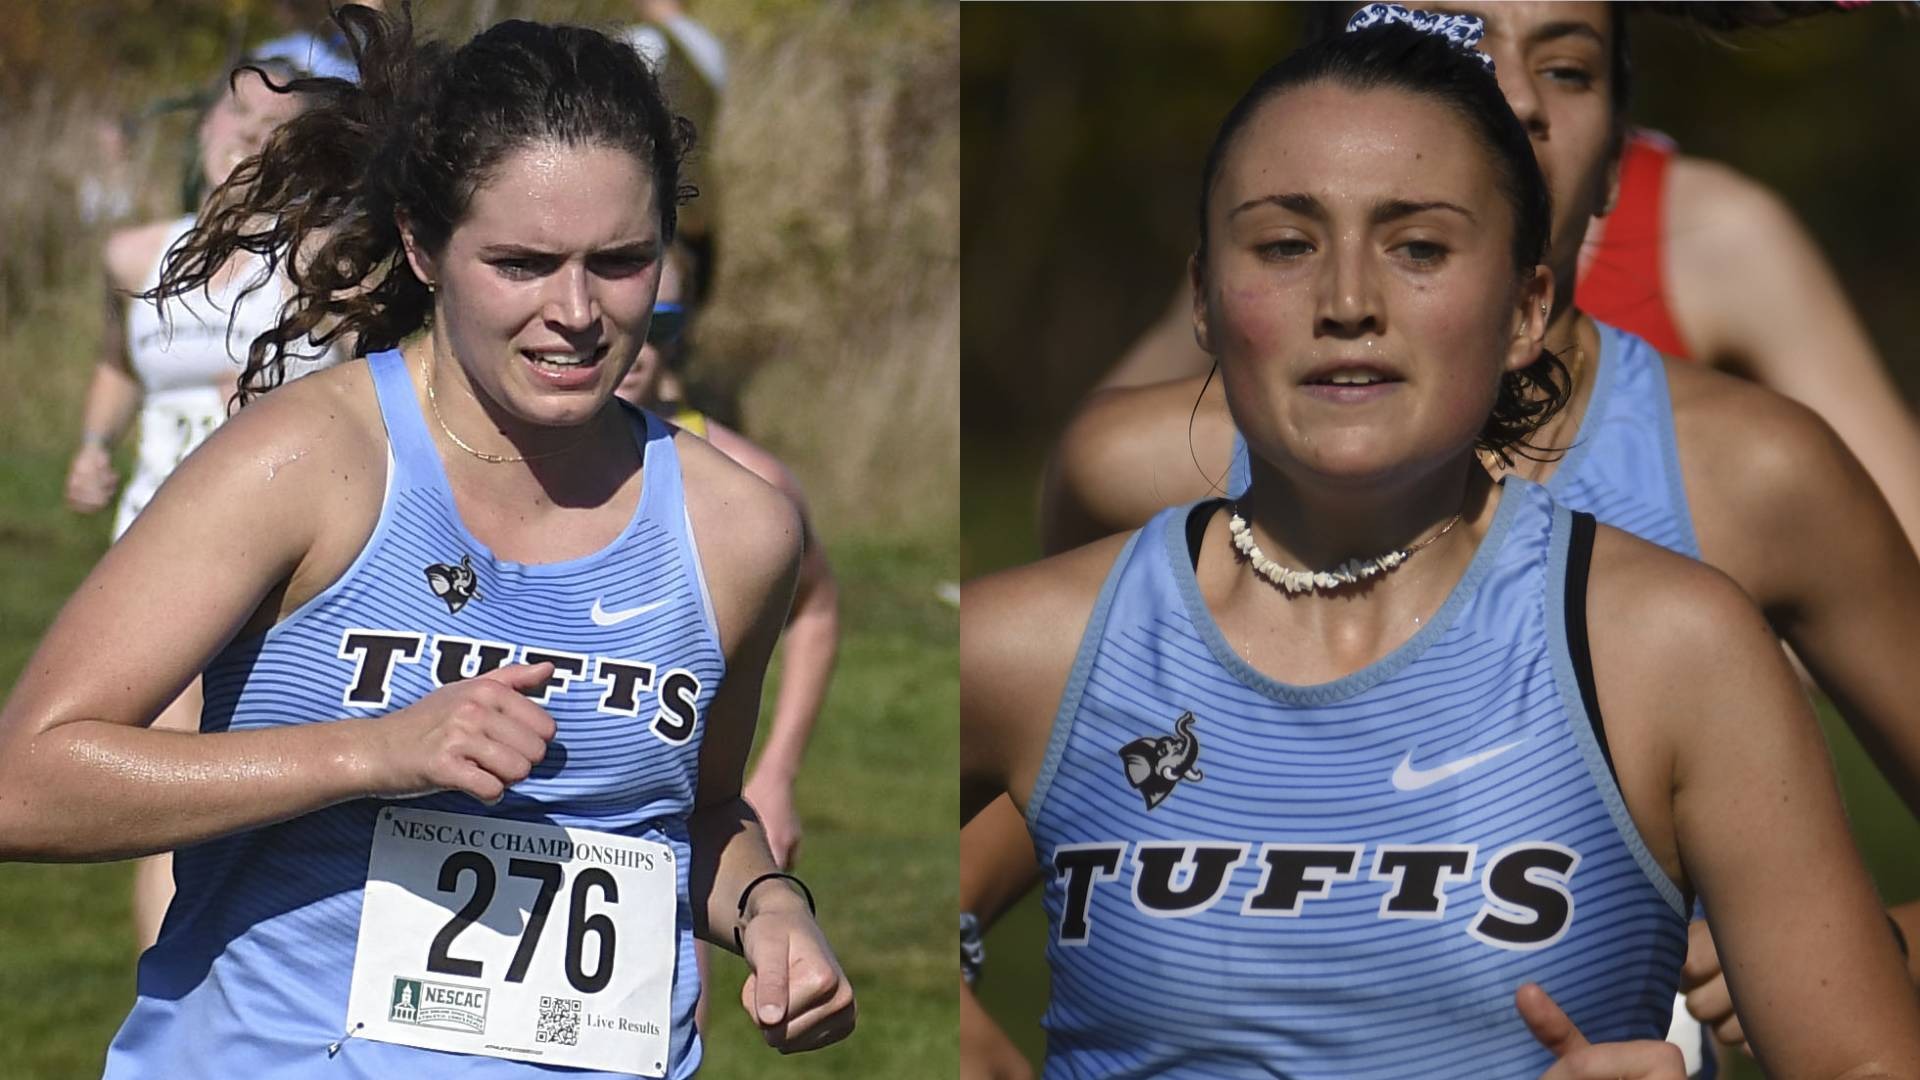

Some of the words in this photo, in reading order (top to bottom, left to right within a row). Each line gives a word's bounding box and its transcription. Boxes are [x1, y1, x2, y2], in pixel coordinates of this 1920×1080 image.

[337, 628, 701, 746] TUFTS
[391, 819, 485, 848] NESCAC
[490, 833, 655, 871] CHAMPIONSHIPS
[426, 850, 620, 994] 276
[1052, 841, 1582, 951] TUFTS
[425, 986, 484, 1008] NESCAC
[587, 1013, 615, 1029] Live
[618, 1017, 661, 1036] Results
